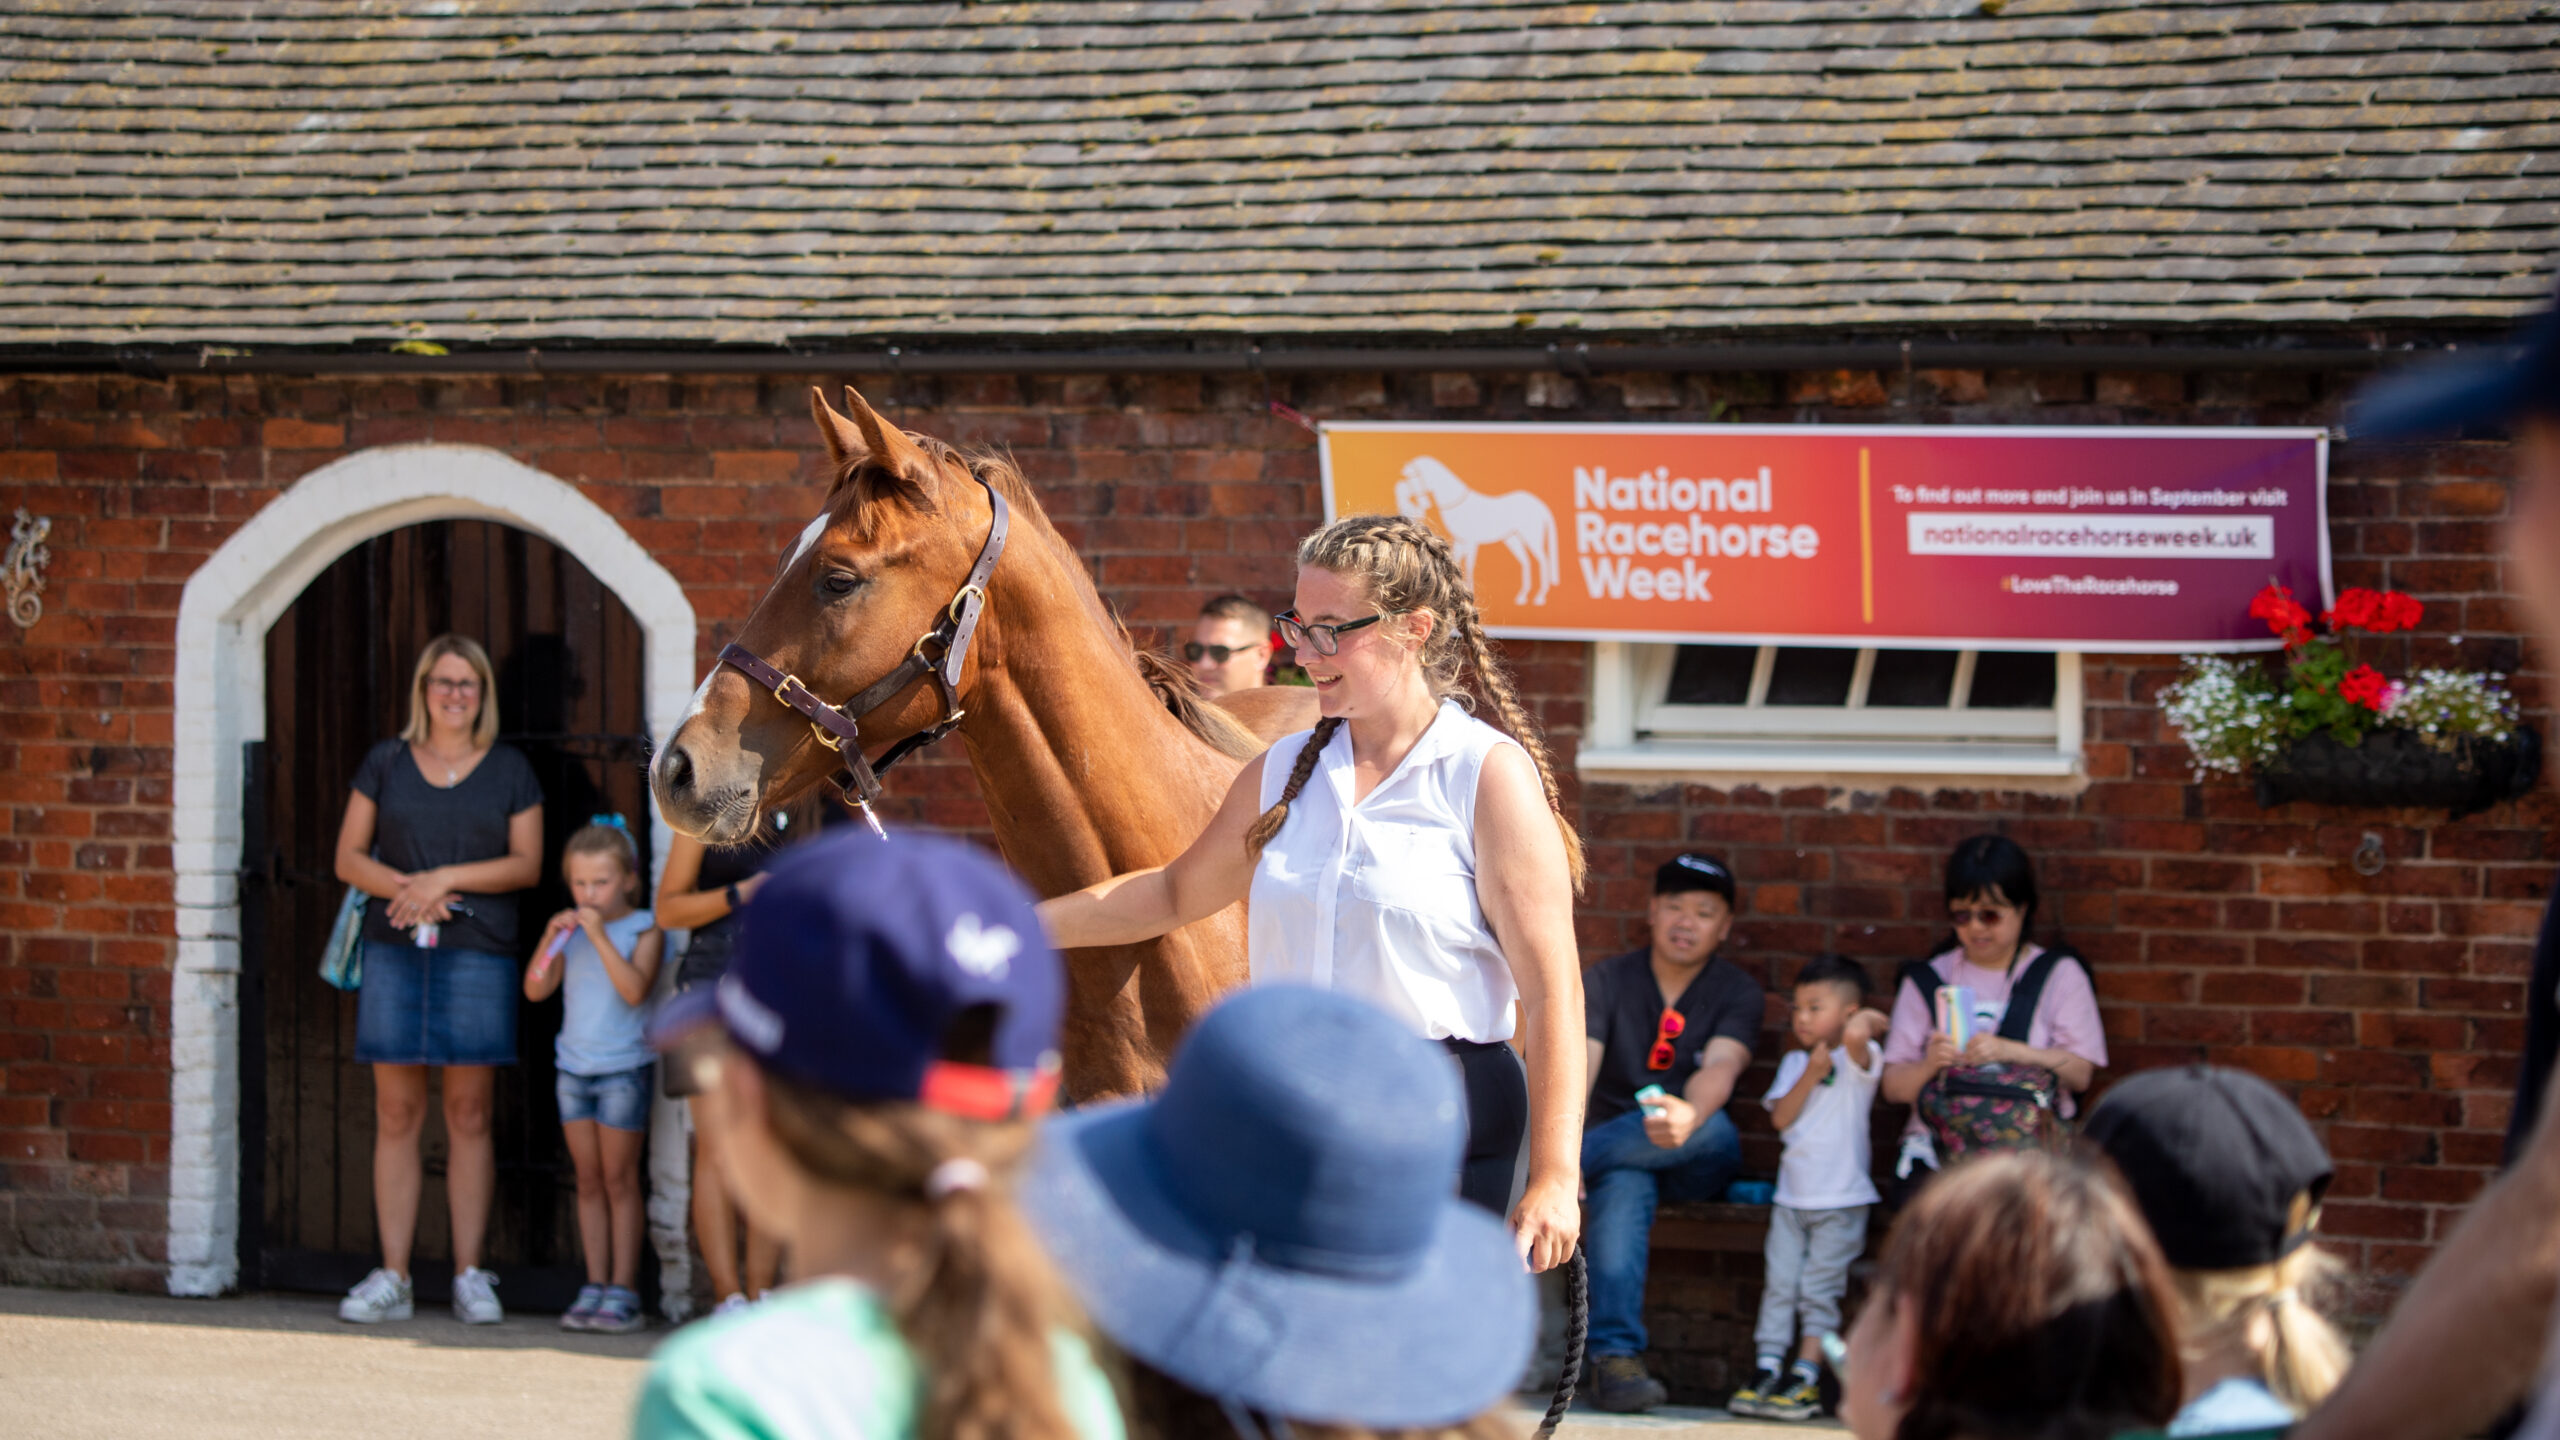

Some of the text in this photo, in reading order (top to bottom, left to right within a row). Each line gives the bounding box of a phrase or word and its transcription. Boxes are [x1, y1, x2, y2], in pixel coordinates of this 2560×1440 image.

[1573, 465, 1772, 512] National
[1891, 484, 2288, 509] To find out more and join us in September visit
[1575, 511, 1819, 559] Racehorse
[1924, 522, 2257, 548] nationalracehorseweek.uk
[1578, 554, 1712, 602] Week
